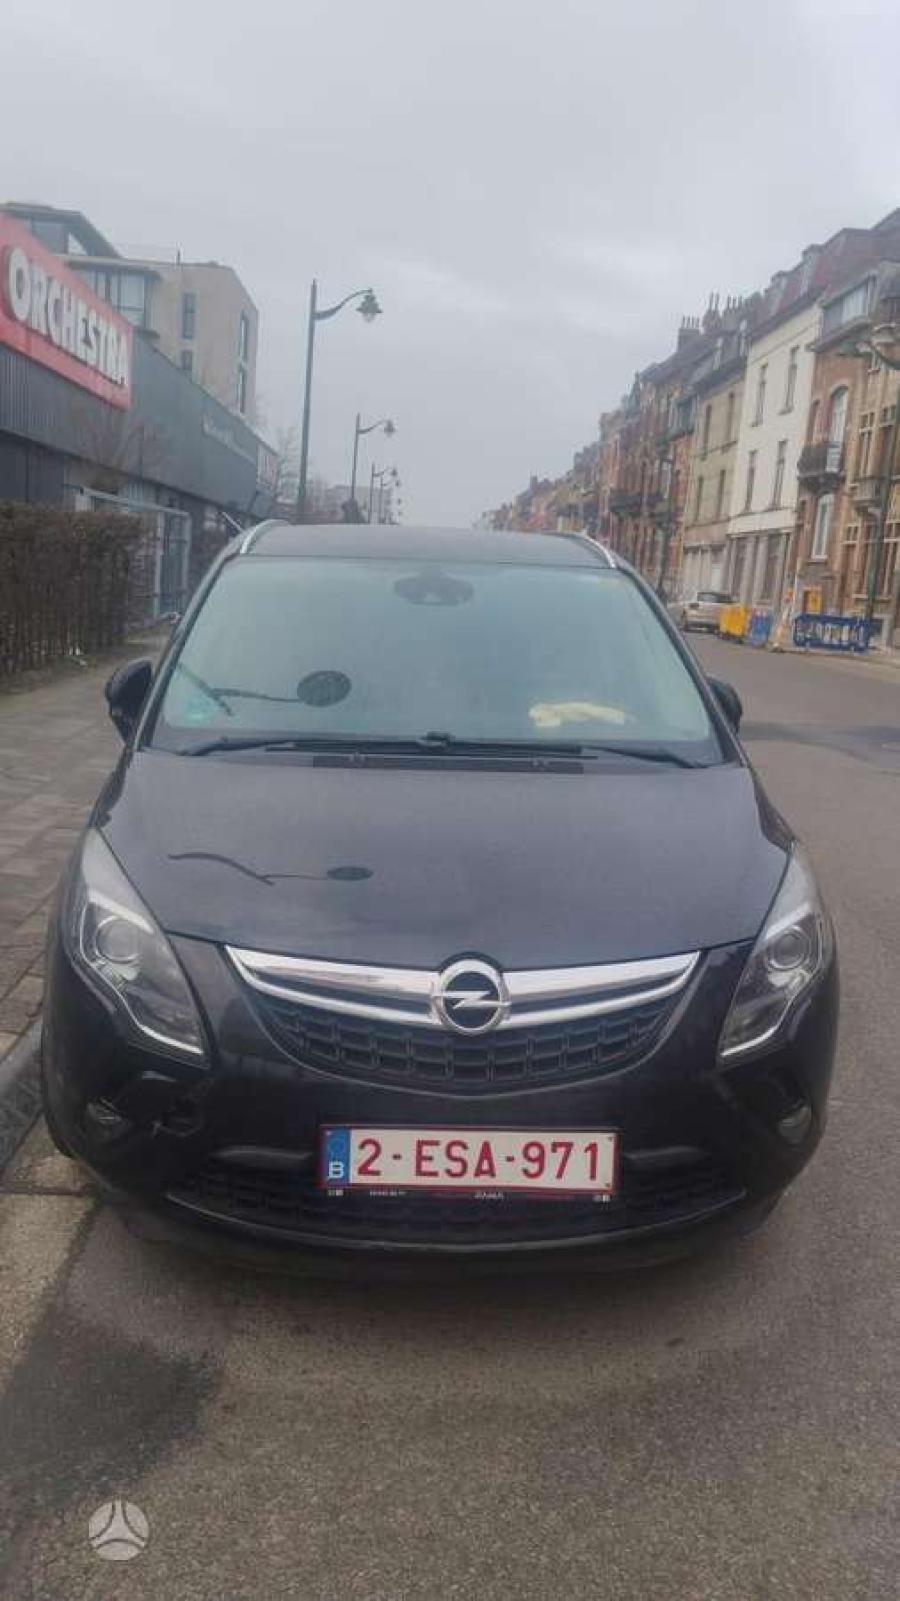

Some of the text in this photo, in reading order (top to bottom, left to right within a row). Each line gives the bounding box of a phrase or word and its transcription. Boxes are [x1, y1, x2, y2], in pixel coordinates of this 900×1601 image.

[9, 247, 128, 386] ORCHESTRA
[328, 1161, 344, 1179] B
[357, 1137, 598, 1181] 2-ESA-971
